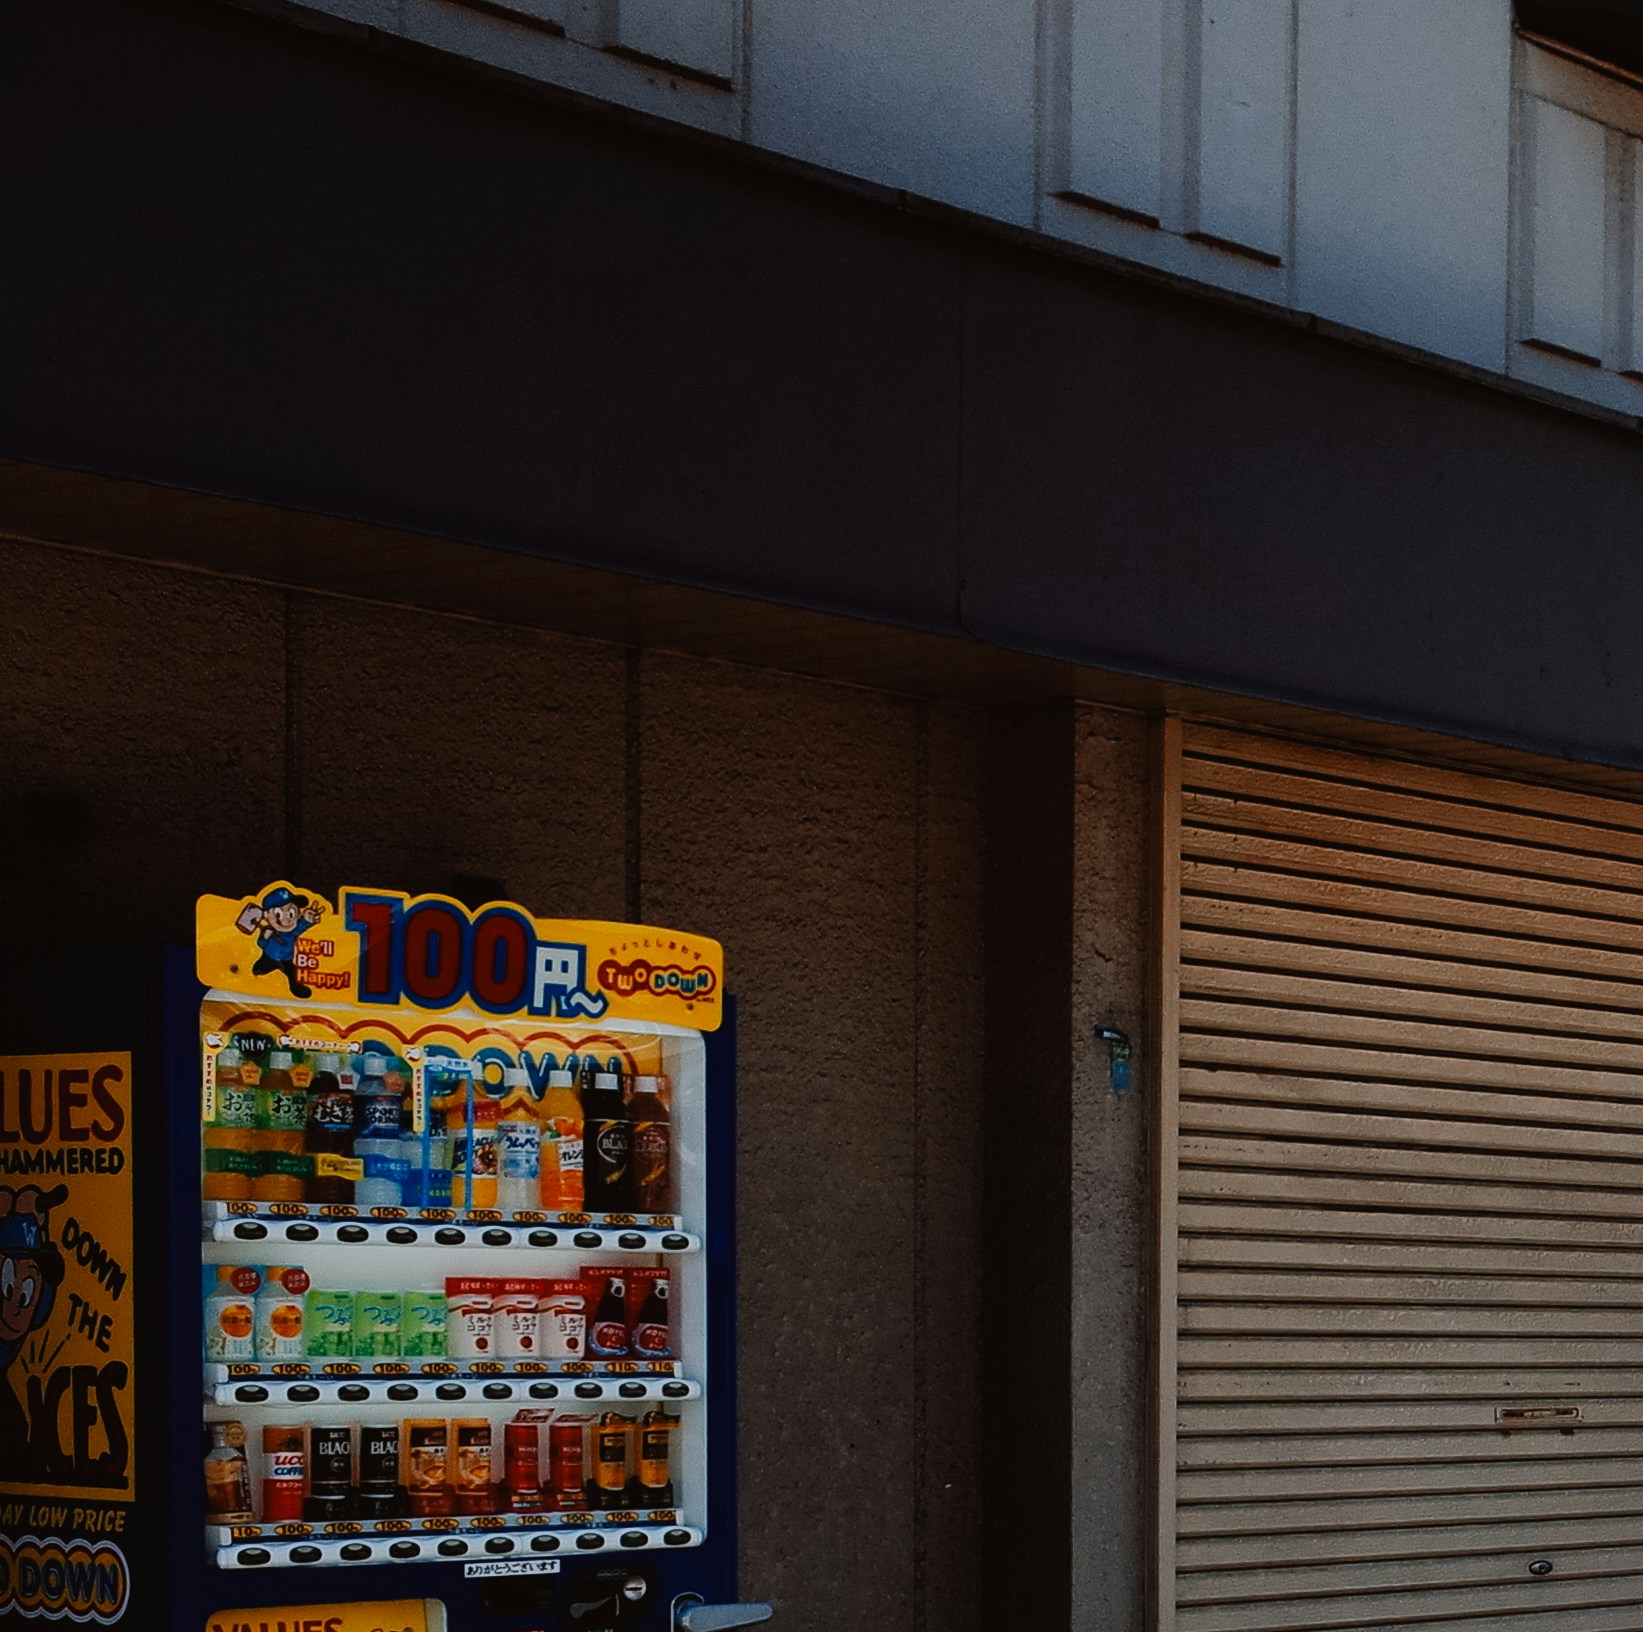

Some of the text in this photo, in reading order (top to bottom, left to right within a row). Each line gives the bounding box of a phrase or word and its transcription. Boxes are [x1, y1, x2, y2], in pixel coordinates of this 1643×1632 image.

[297, 939, 333, 956] We'll
[297, 953, 318, 969] Be
[297, 970, 351, 989] Happy!
[605, 966, 710, 994] TWO DOWN
[240, 1038, 267, 1052] NEW
[275, 1204, 305, 1214] 100
[324, 1206, 356, 1216] 100
[376, 1207, 405, 1217] 100
[425, 1209, 454, 1219] 100
[475, 1210, 501, 1221] 100
[520, 1211, 546, 1222] 100
[565, 1212, 591, 1223] 100
[611, 1214, 636, 1224] 100
[61, 1216, 127, 1301] DOWN
[68, 1292, 113, 1354] THE
[229, 1364, 258, 1374] 100
[279, 1363, 309, 1374] 100
[329, 1363, 359, 1374] 100
[379, 1363, 407, 1374] 100
[428, 1363, 456, 1374] 100
[475, 1362, 503, 1373] 100
[520, 1362, 547, 1373] 100
[566, 1362, 594, 1373] 100
[610, 1362, 637, 1373] 110
[651, 1362, 674, 1373] 110
[0, 1503, 126, 1534] AY LOW PRICE
[478, 1517, 505, 1528] 100
[522, 1515, 549, 1526] 100
[565, 1513, 593, 1524] 100
[611, 1512, 638, 1523] 100
[281, 1524, 312, 1534] 100
[331, 1523, 361, 1533] 100
[381, 1521, 410, 1532] 100
[429, 1519, 457, 1530] 100
[231, 1526, 260, 1537] 10
[466, 1560, 558, 1577] ありがとうございます
[18, 1555, 120, 1607] DOWN
